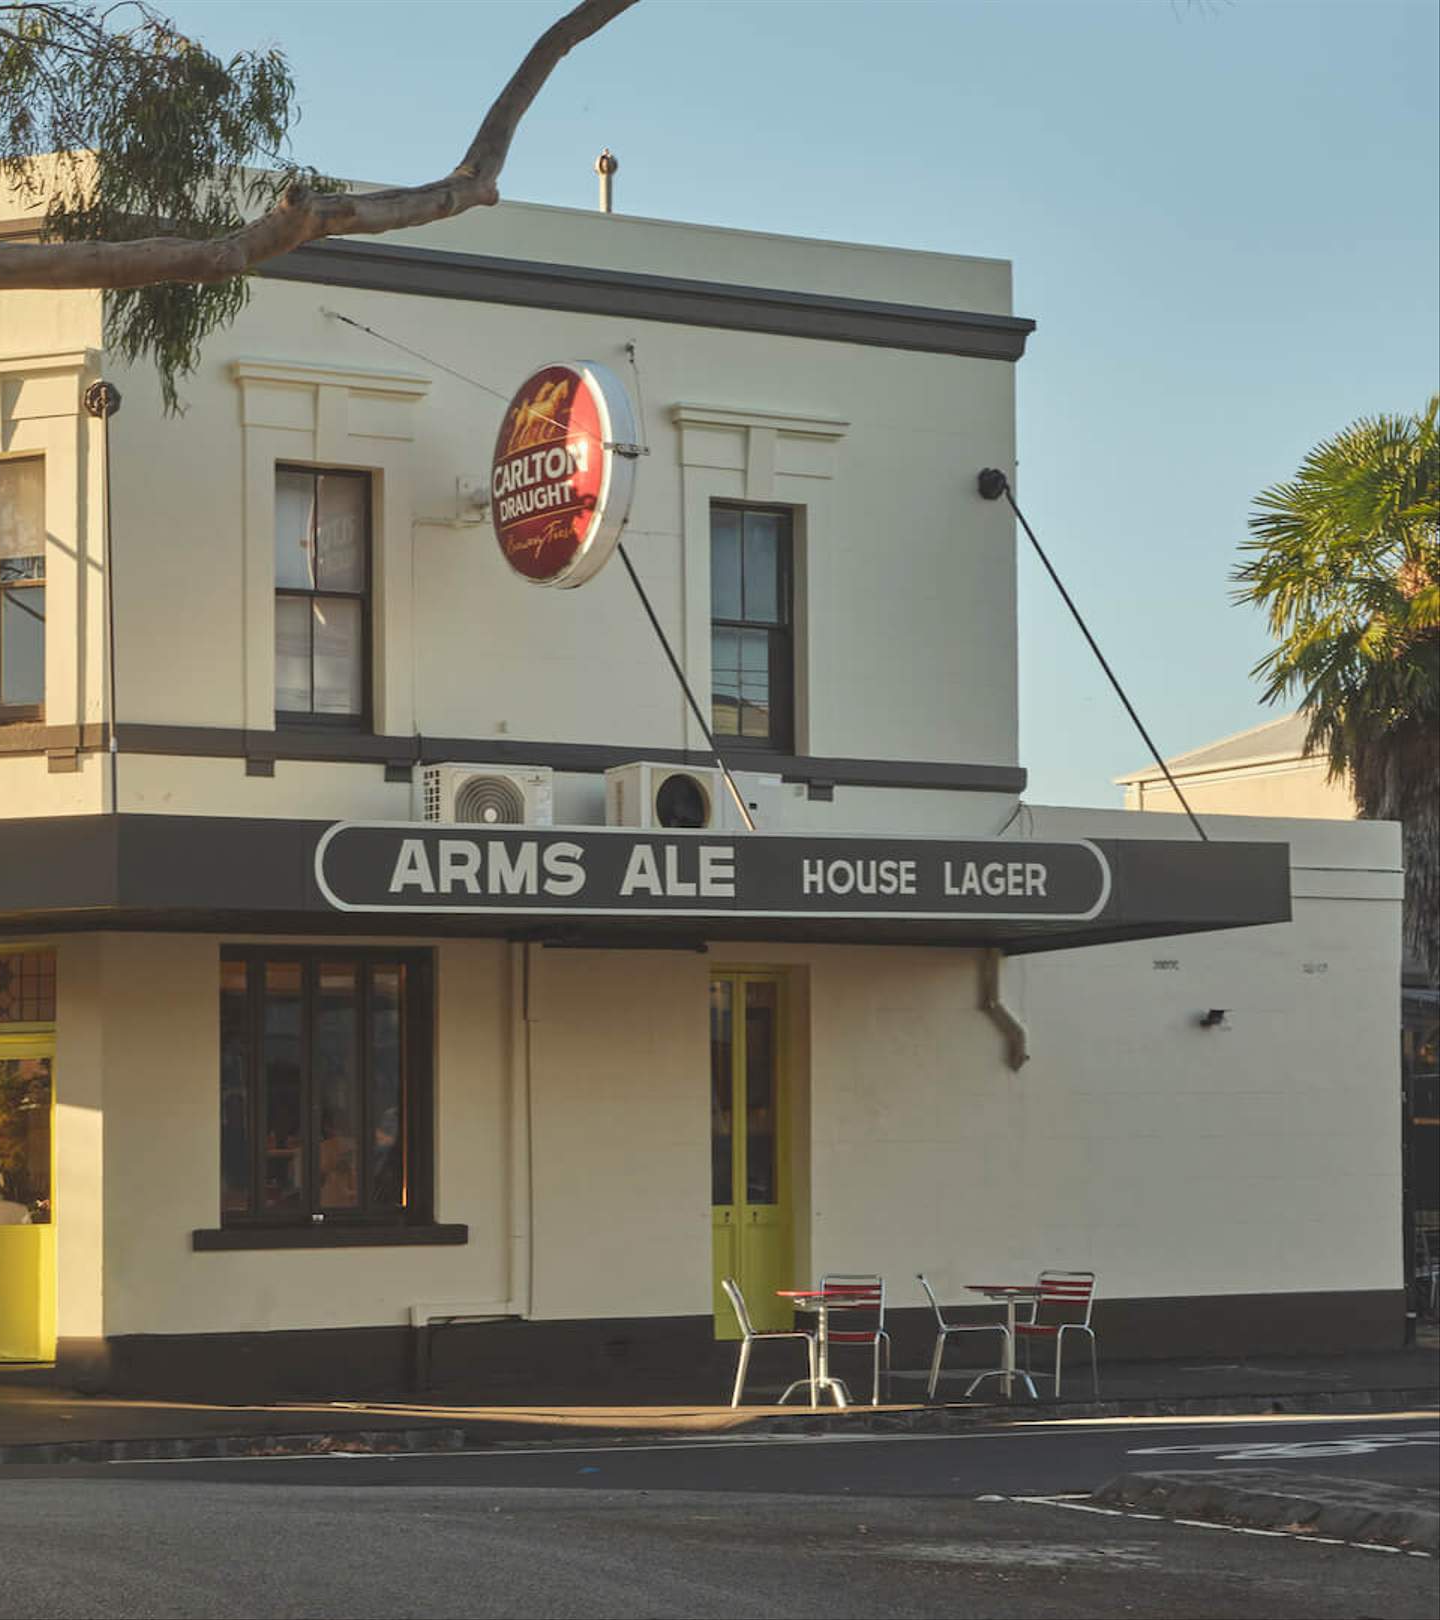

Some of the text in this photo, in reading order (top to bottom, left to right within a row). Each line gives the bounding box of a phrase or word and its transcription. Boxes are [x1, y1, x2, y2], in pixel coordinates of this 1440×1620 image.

[493, 440, 588, 499] CARLTON
[500, 479, 574, 522] DRAUGHT
[388, 839, 735, 897] ARMS ALE
[803, 859, 1047, 896] HOUSE LAGER
